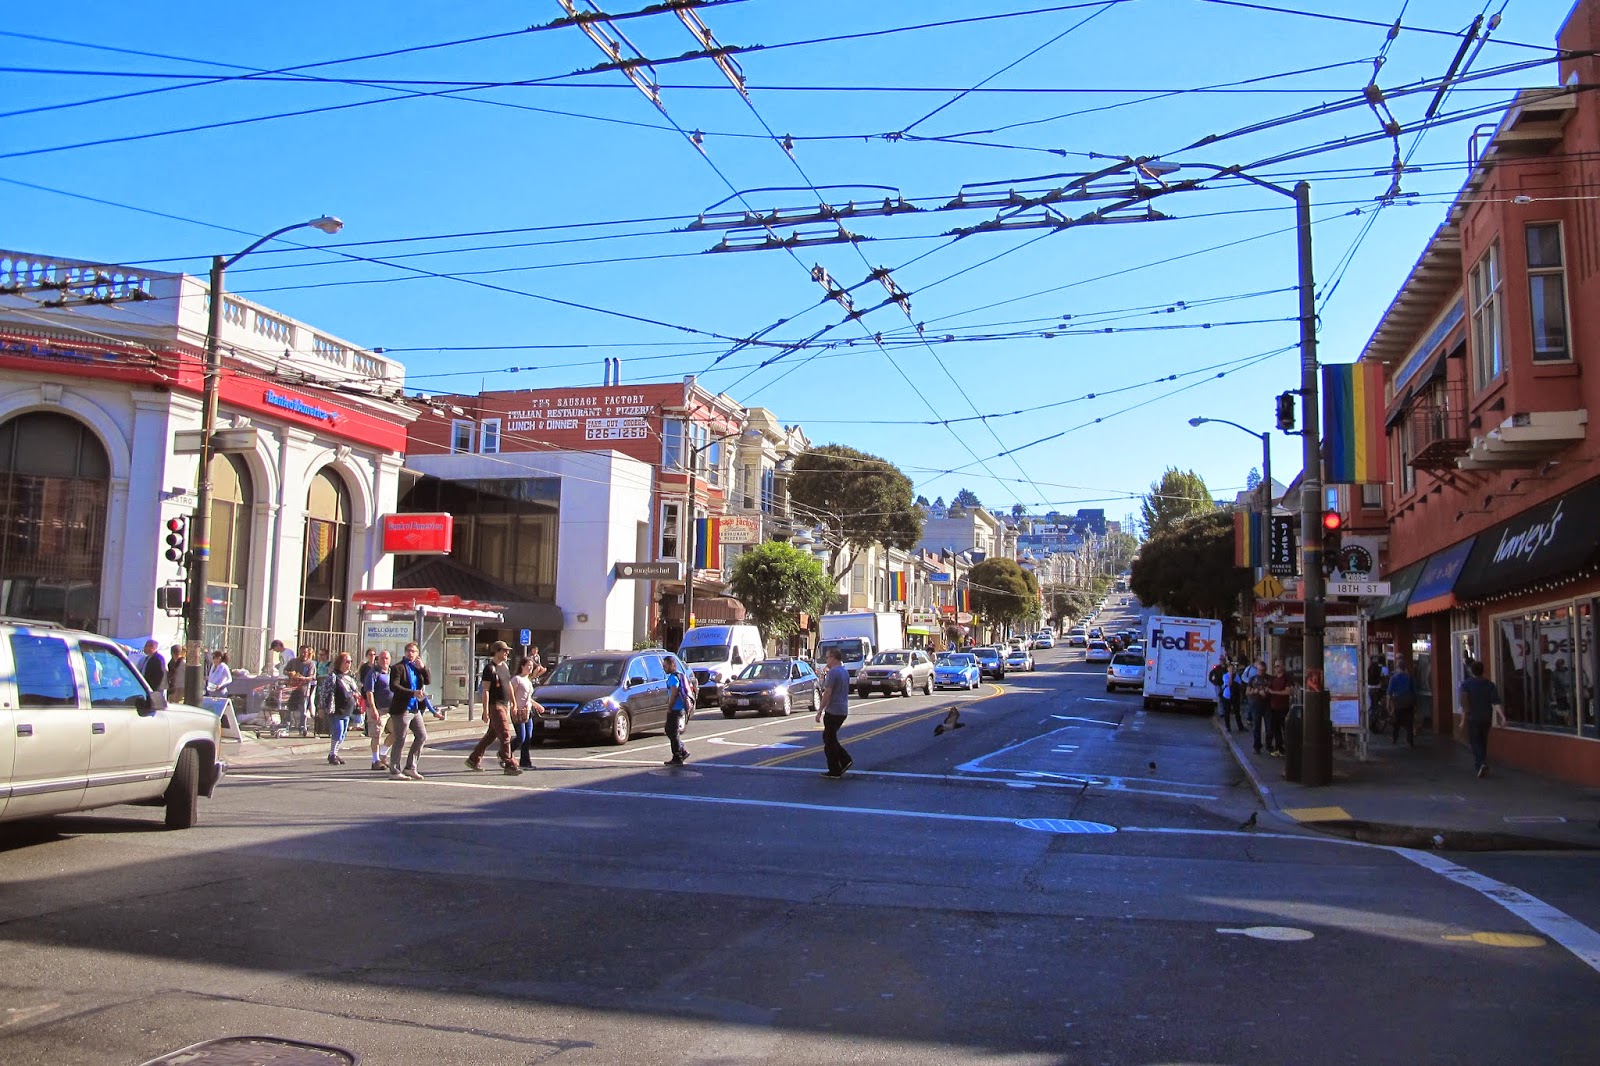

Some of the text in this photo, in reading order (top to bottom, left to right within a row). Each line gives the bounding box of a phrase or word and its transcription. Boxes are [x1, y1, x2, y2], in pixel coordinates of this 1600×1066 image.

[267, 389, 288, 407] Bank
[299, 400, 329, 419] America
[557, 397, 597, 407] SAUSAGE
[604, 395, 644, 405] FACTORY
[508, 409, 543, 420] ITALIAN
[547, 407, 602, 418] RESTAURANT
[615, 405, 655, 416] PIZZERIA
[507, 419, 579, 431] LUNCH & DINNER
[606, 419, 619, 427] OUT
[587, 428, 646, 438] 626-1250
[166, 495, 193, 505] CASTRO
[388, 521, 444, 530] Bank of America
[719, 517, 758, 530] sage Factory
[1492, 500, 1564, 563] harvey's
[1281, 523, 1289, 562] BISTRO
[633, 566, 670, 575] sunglass hut
[1337, 585, 1378, 593] 18TH ST
[1152, 629, 1216, 652] FedEx
